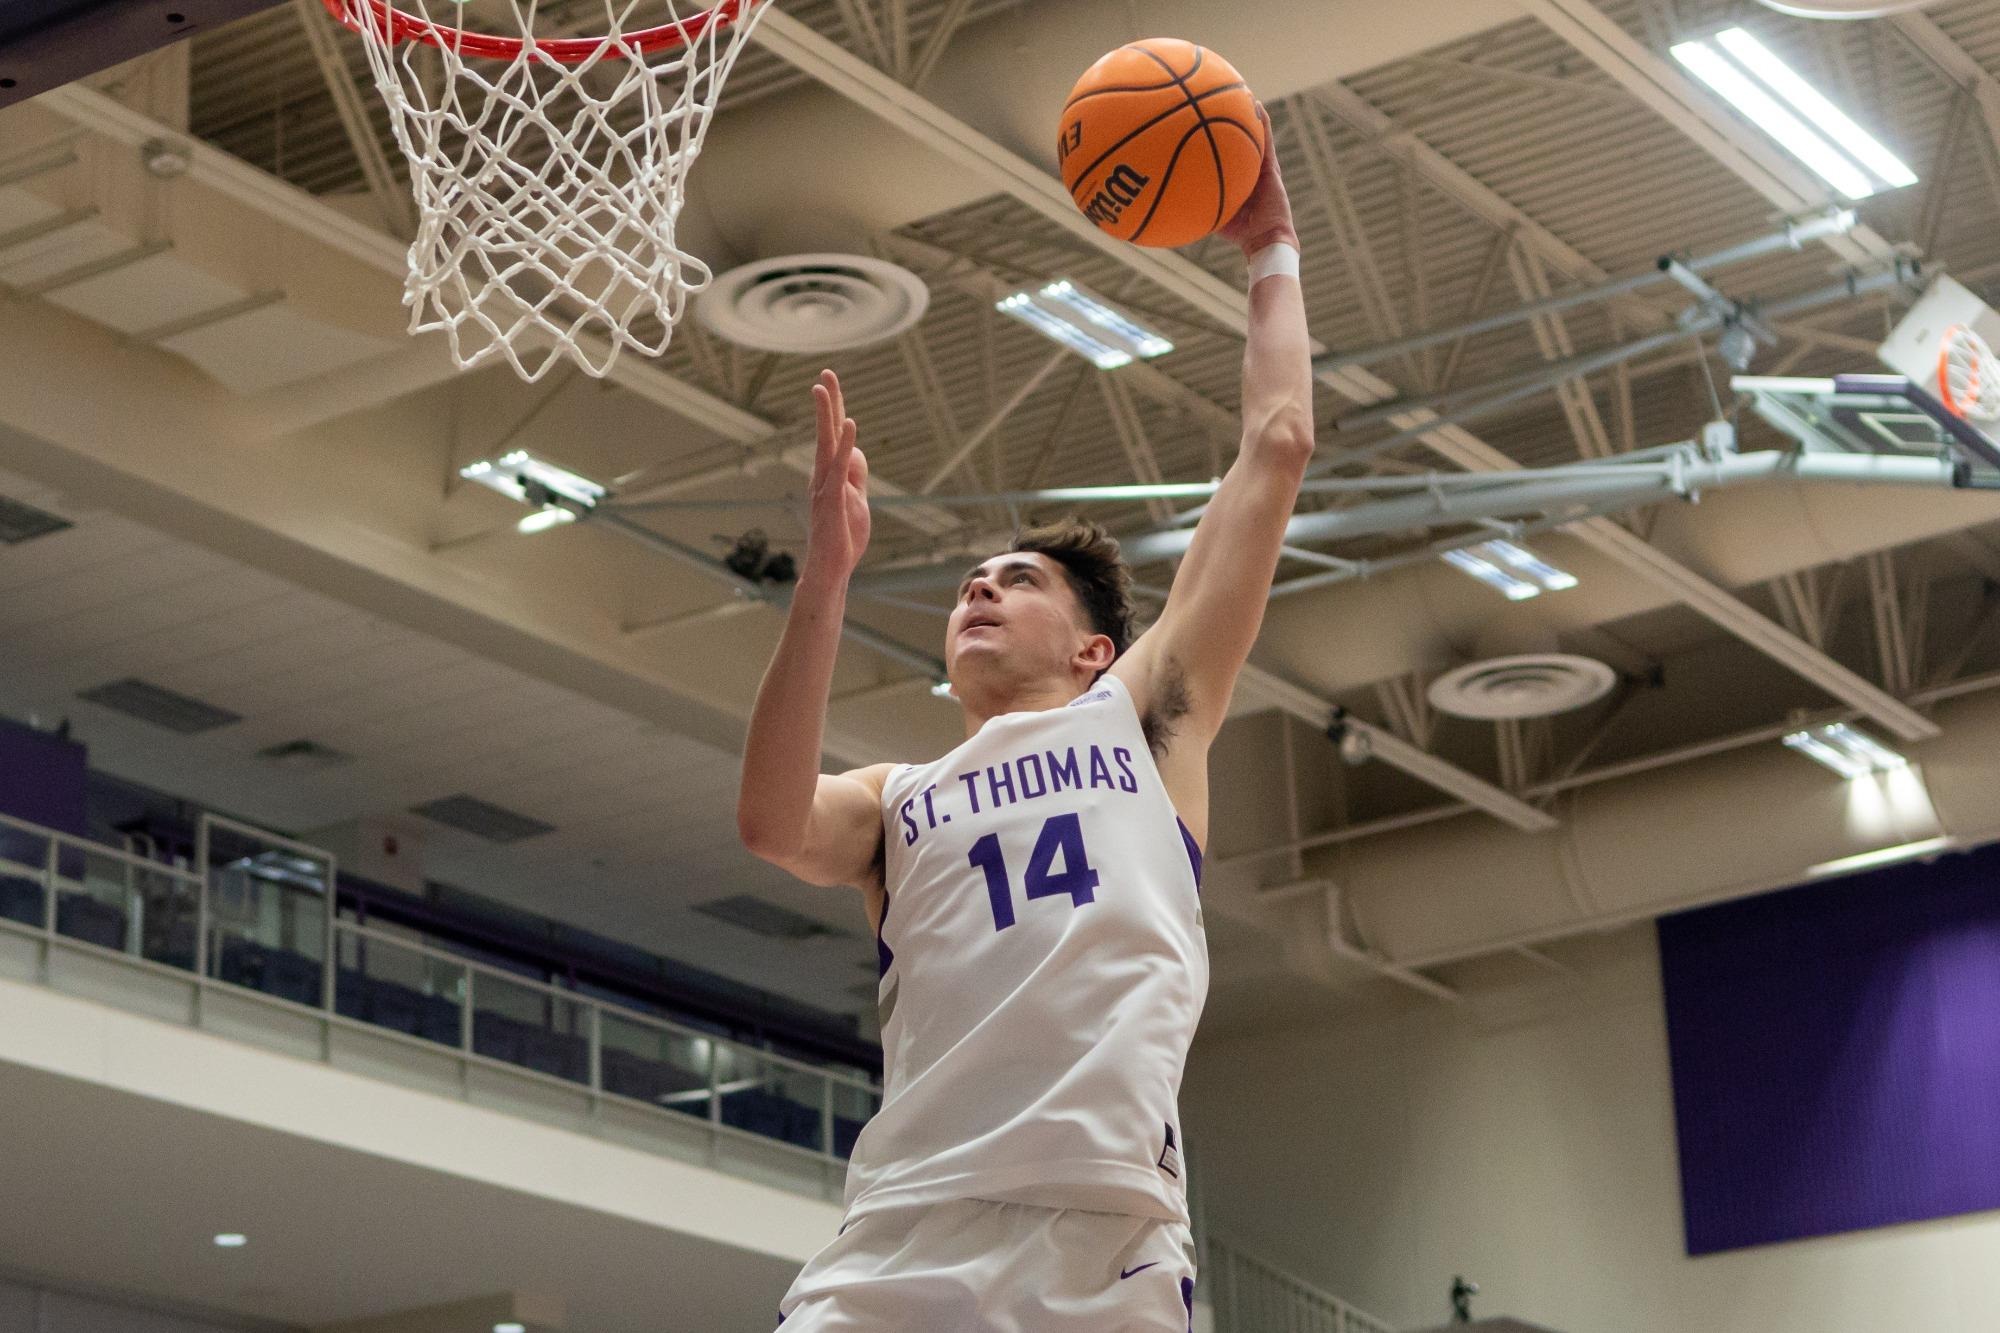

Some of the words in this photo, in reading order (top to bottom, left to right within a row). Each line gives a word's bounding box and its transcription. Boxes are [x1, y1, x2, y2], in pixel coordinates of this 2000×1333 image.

[901, 784, 951, 847] ST.
[958, 744, 1138, 814] THOMAS
[967, 813, 1100, 932] 14
